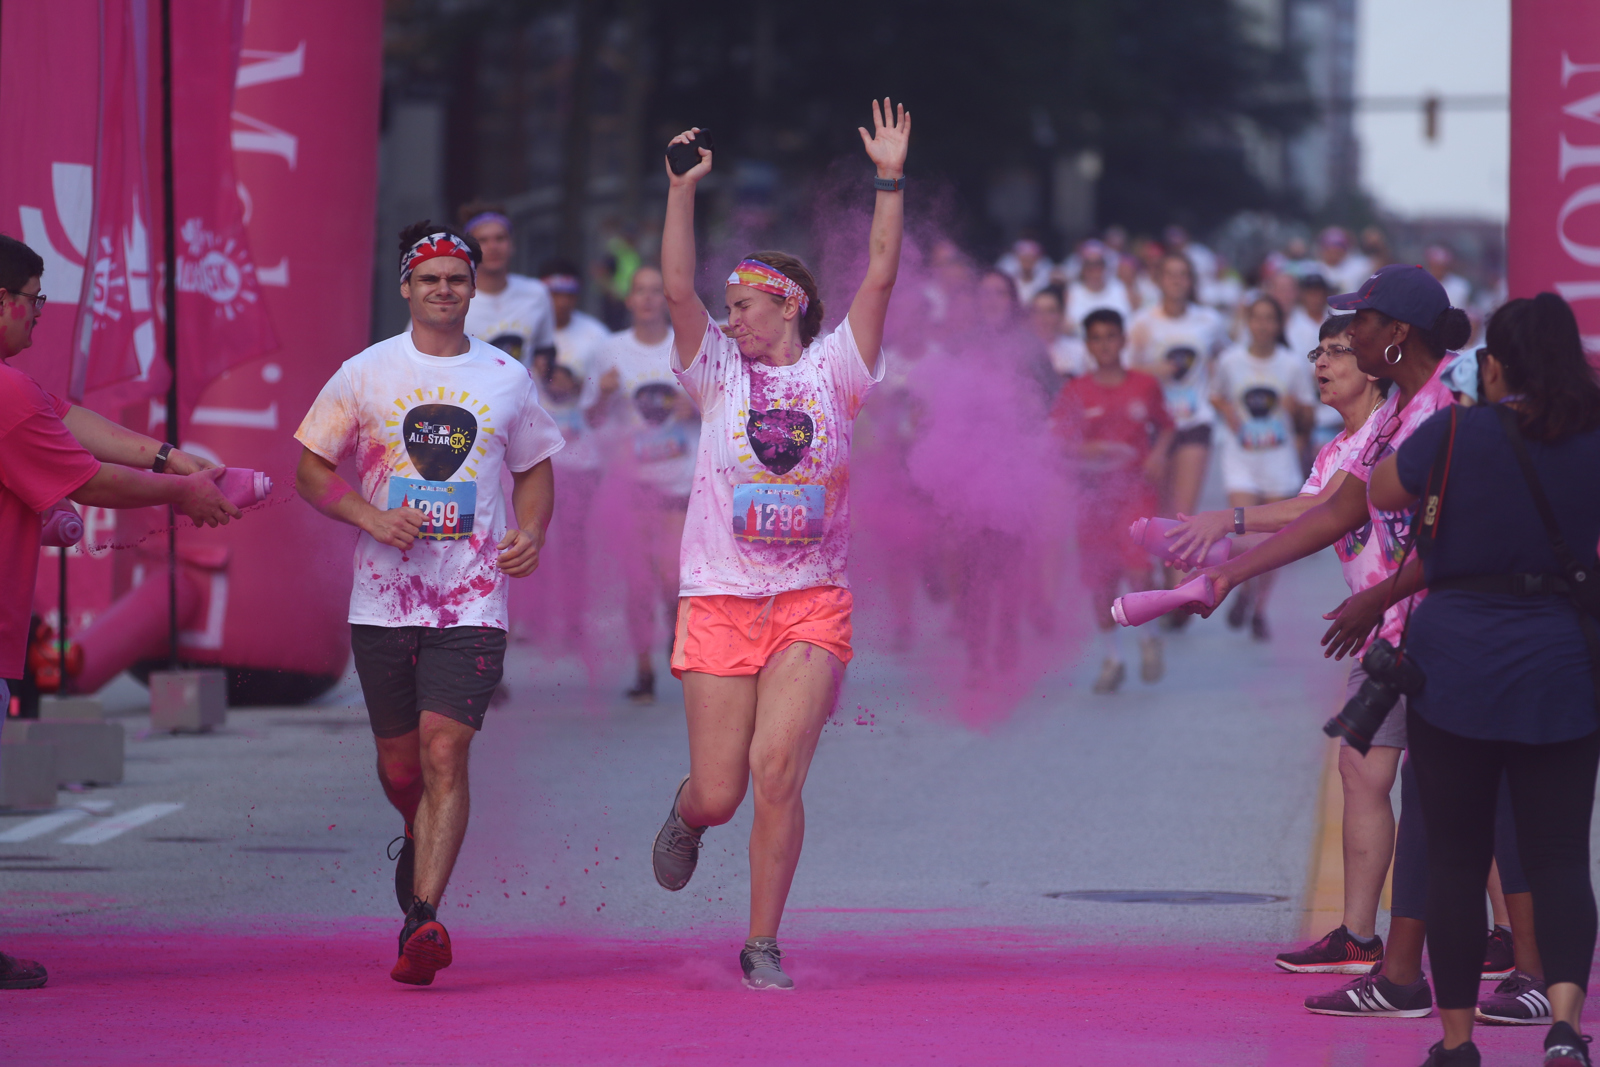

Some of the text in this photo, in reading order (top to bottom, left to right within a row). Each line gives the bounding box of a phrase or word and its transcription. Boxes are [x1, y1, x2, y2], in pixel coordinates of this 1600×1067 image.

[452, 436, 463, 446] 5K
[755, 504, 807, 531] 1298
[1424, 495, 1439, 526] EOS
